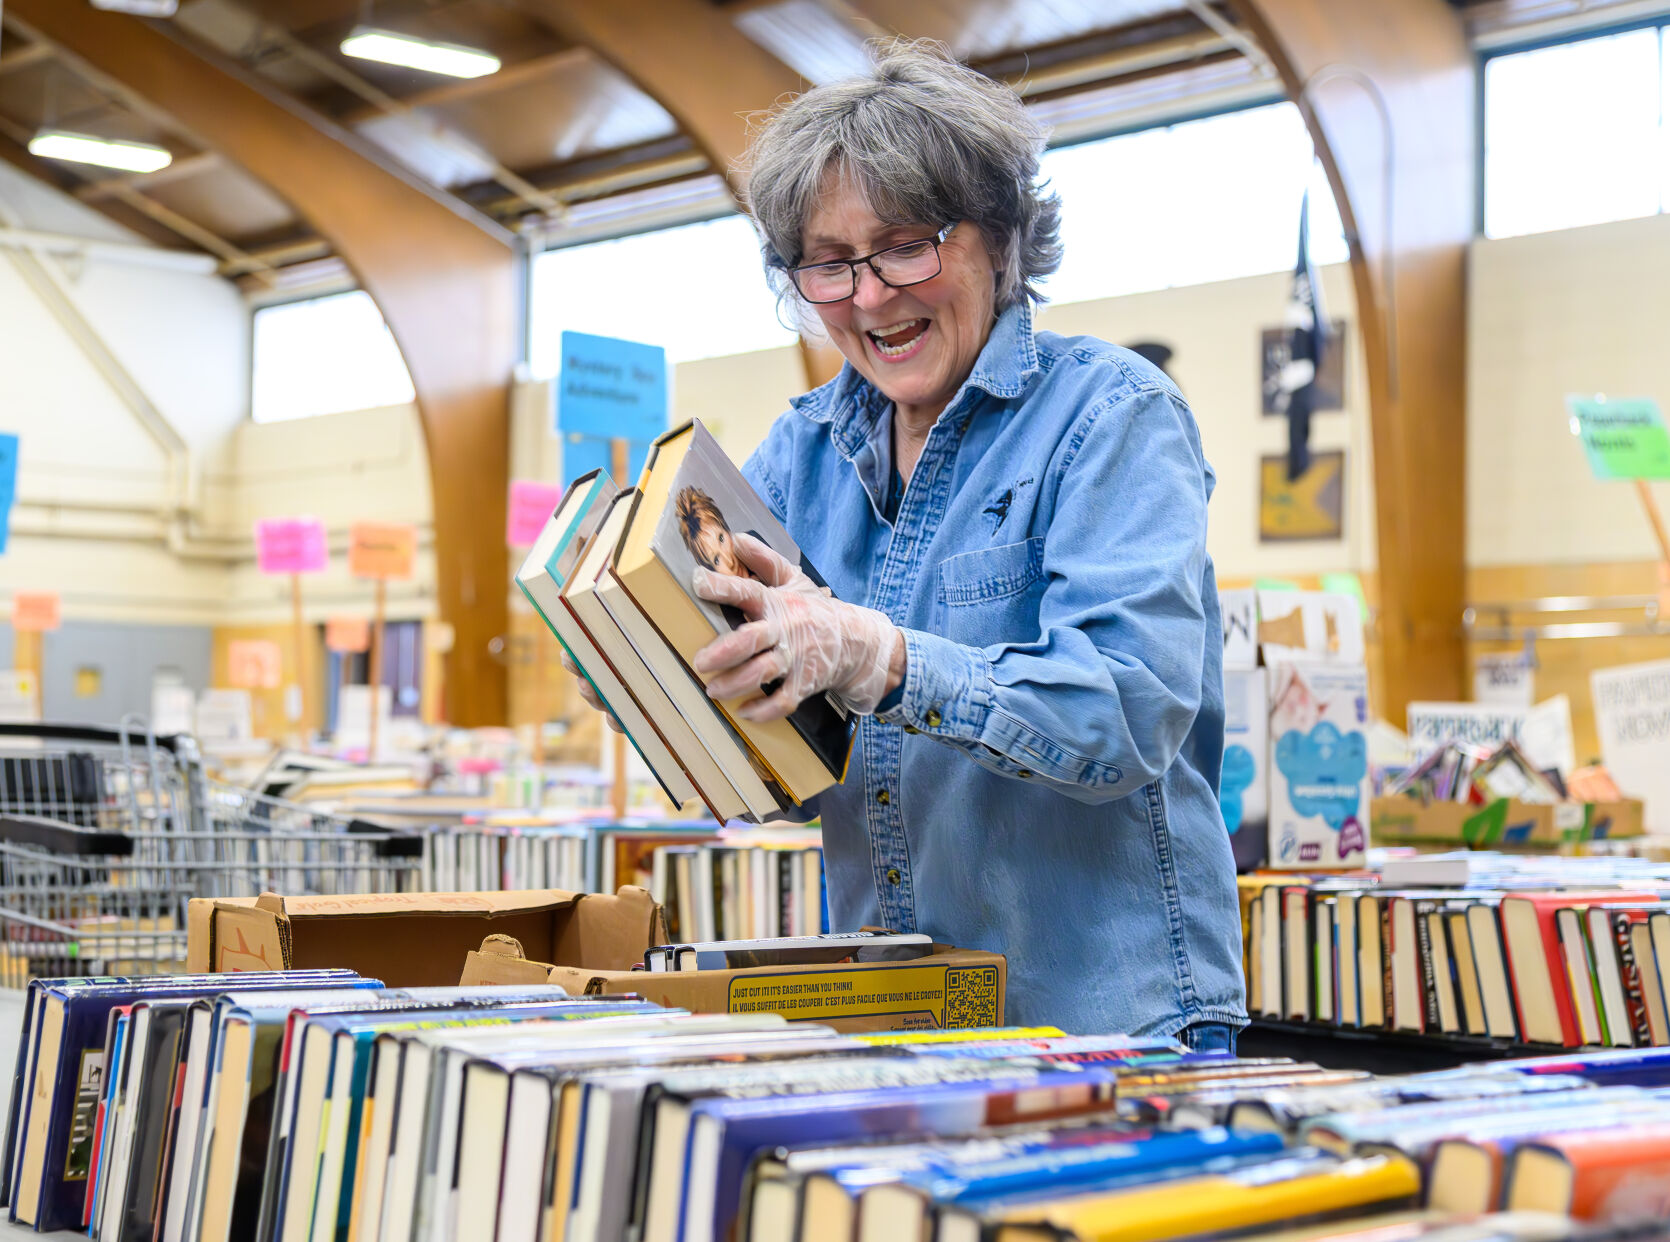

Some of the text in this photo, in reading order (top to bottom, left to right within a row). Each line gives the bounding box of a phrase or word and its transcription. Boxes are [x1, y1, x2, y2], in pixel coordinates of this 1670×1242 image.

[732, 988, 748, 998] JUST
[749, 986, 761, 997] CUT
[782, 984, 802, 995] EASIER
[803, 983, 820, 993] THAN
[820, 982, 831, 993] YOU
[832, 981, 852, 992] THINK!
[732, 1002, 740, 1012] IL
[740, 1001, 756, 1012] VOUS
[757, 1000, 777, 1011] SUFFIT
[777, 999, 786, 1010] DE
[786, 998, 798, 1009] LES
[825, 995, 841, 1007] C'EST
[842, 994, 856, 1005] PLUS
[857, 993, 876, 1005] FACILE
[876, 992, 888, 1004] QUE
[889, 991, 904, 1003] VOUS
[904, 990, 913, 1001] NE
[913, 990, 921, 1001] LE
